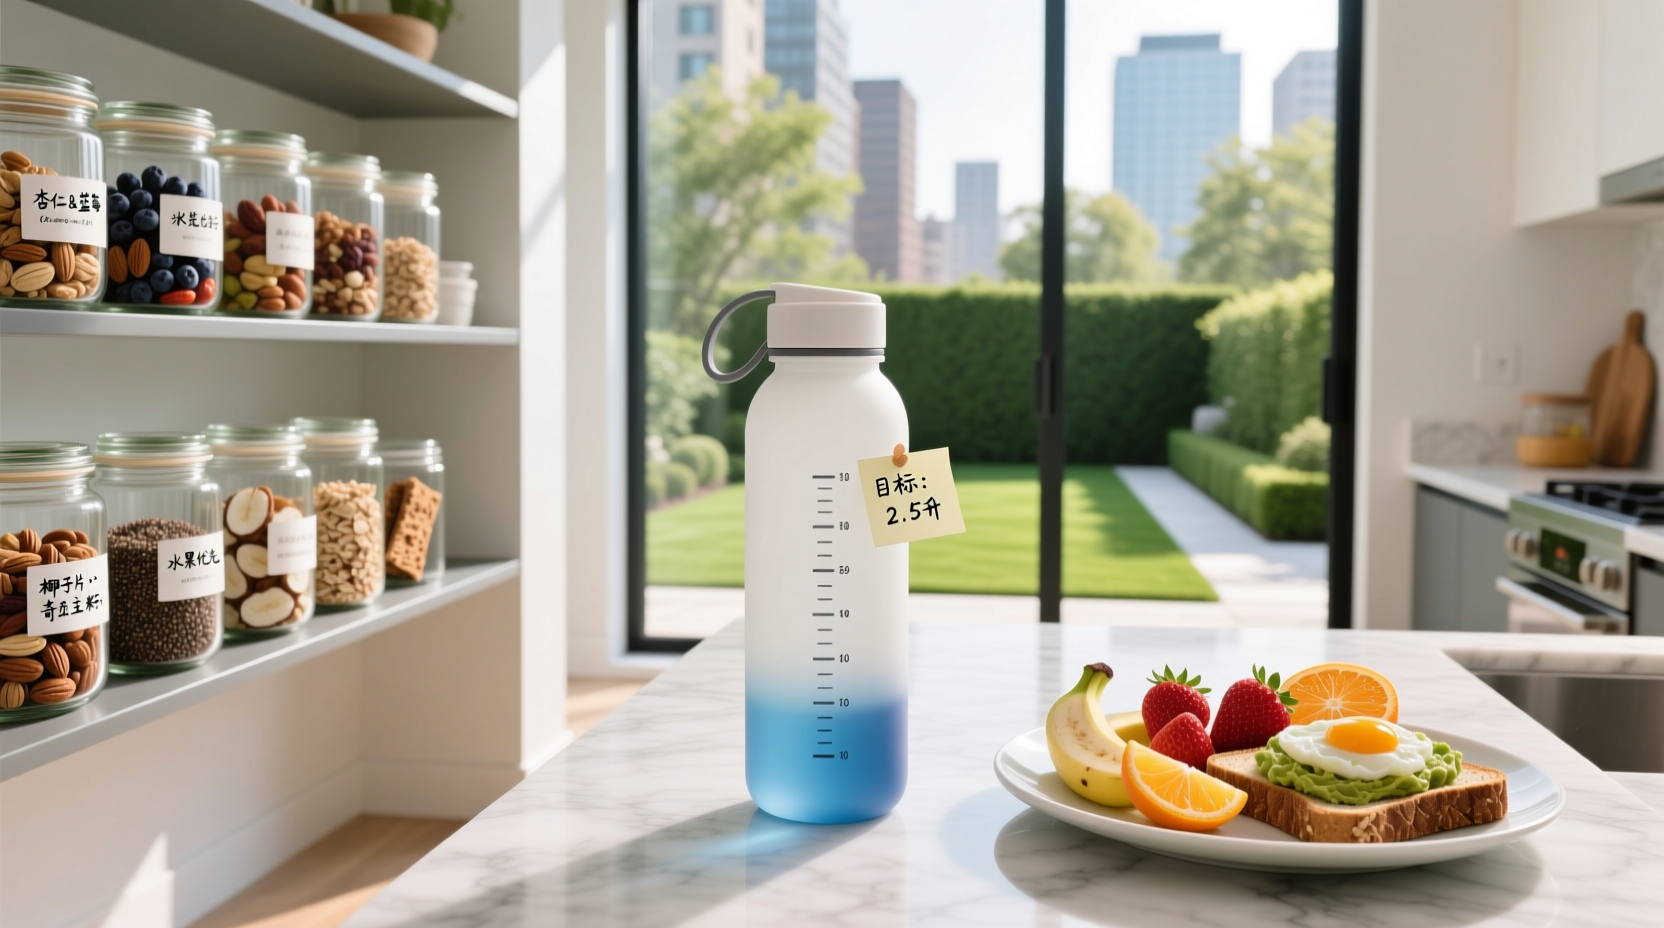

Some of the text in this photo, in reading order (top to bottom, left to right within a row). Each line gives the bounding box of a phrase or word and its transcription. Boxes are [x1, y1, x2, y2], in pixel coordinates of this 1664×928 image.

[839, 653, 850, 663] 10
[839, 698, 850, 707] 10
[839, 750, 849, 760] 10
